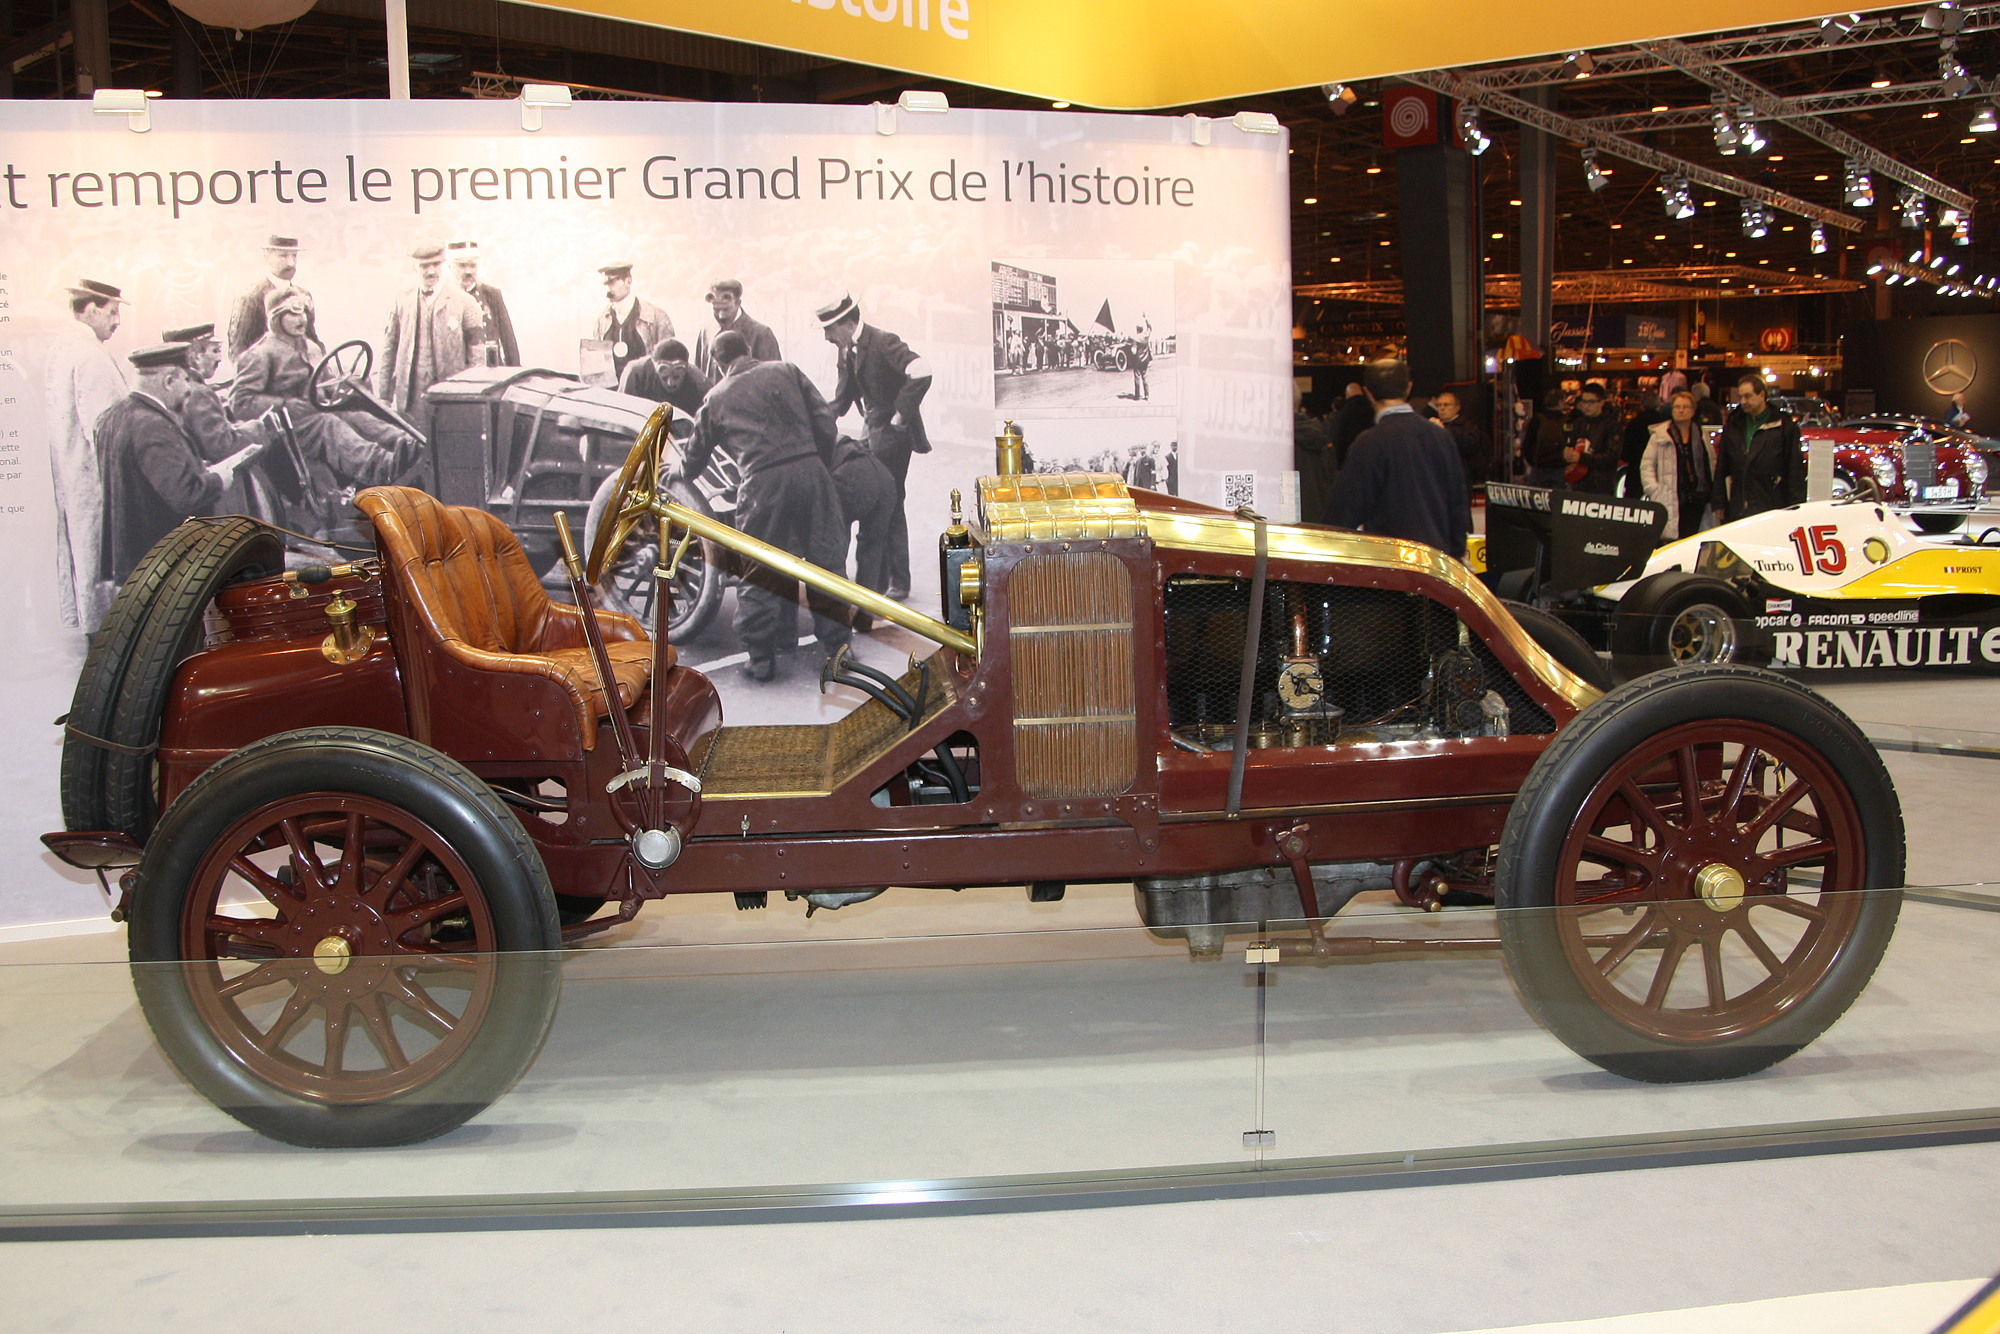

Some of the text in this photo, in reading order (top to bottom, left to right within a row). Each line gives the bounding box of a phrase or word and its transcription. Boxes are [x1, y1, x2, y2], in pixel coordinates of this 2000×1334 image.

[0, 163, 29, 209] t
[48, 160, 328, 220] remporte
[345, 154, 392, 203] le
[411, 156, 627, 215] premier
[642, 155, 801, 201] Grand
[817, 157, 914, 201] Prix
[929, 158, 987, 203] de
[9, 429, 19, 438] et
[7, 471, 23, 481] par
[8, 505, 26, 514] que
[1562, 499, 1655, 525] MICHELIN
[1788, 523, 1848, 577] 15
[1753, 559, 1796, 573] Turbo
[1955, 566, 1984, 574] PROST
[1808, 613, 1850, 625] FACOM
[1868, 610, 1920, 624] speedline
[1767, 626, 1978, 669] RENAULT
